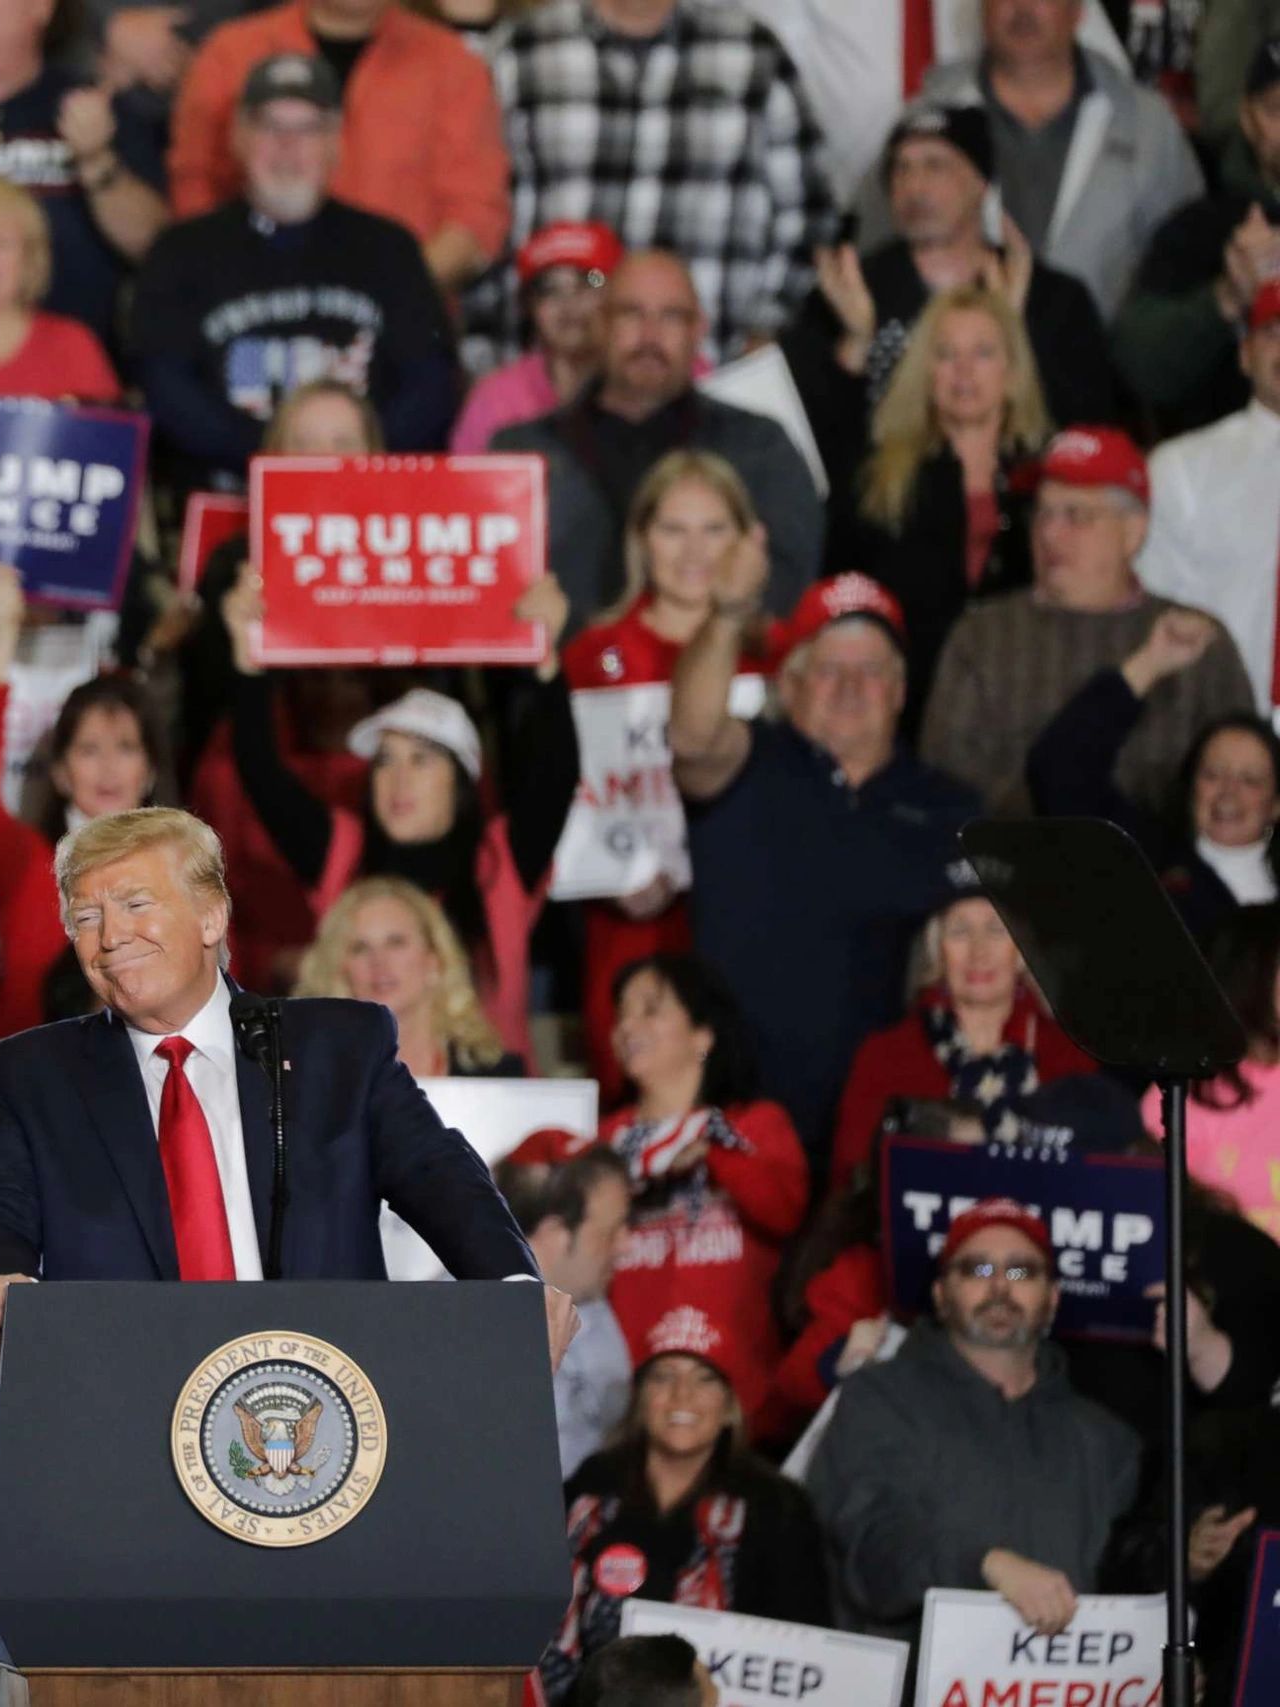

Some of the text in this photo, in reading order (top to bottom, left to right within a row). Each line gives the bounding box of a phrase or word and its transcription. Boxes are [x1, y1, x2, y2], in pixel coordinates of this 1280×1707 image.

[272, 515, 518, 554] TRUMP
[295, 556, 496, 584] PENCE
[903, 1190, 1153, 1254] TMP
[180, 1339, 379, 1536] SEAL OF THE PRESIDENT OF THE UNITED STATES
[1009, 1631, 1134, 1665] KEEP
[708, 1648, 824, 1698] KEEP
